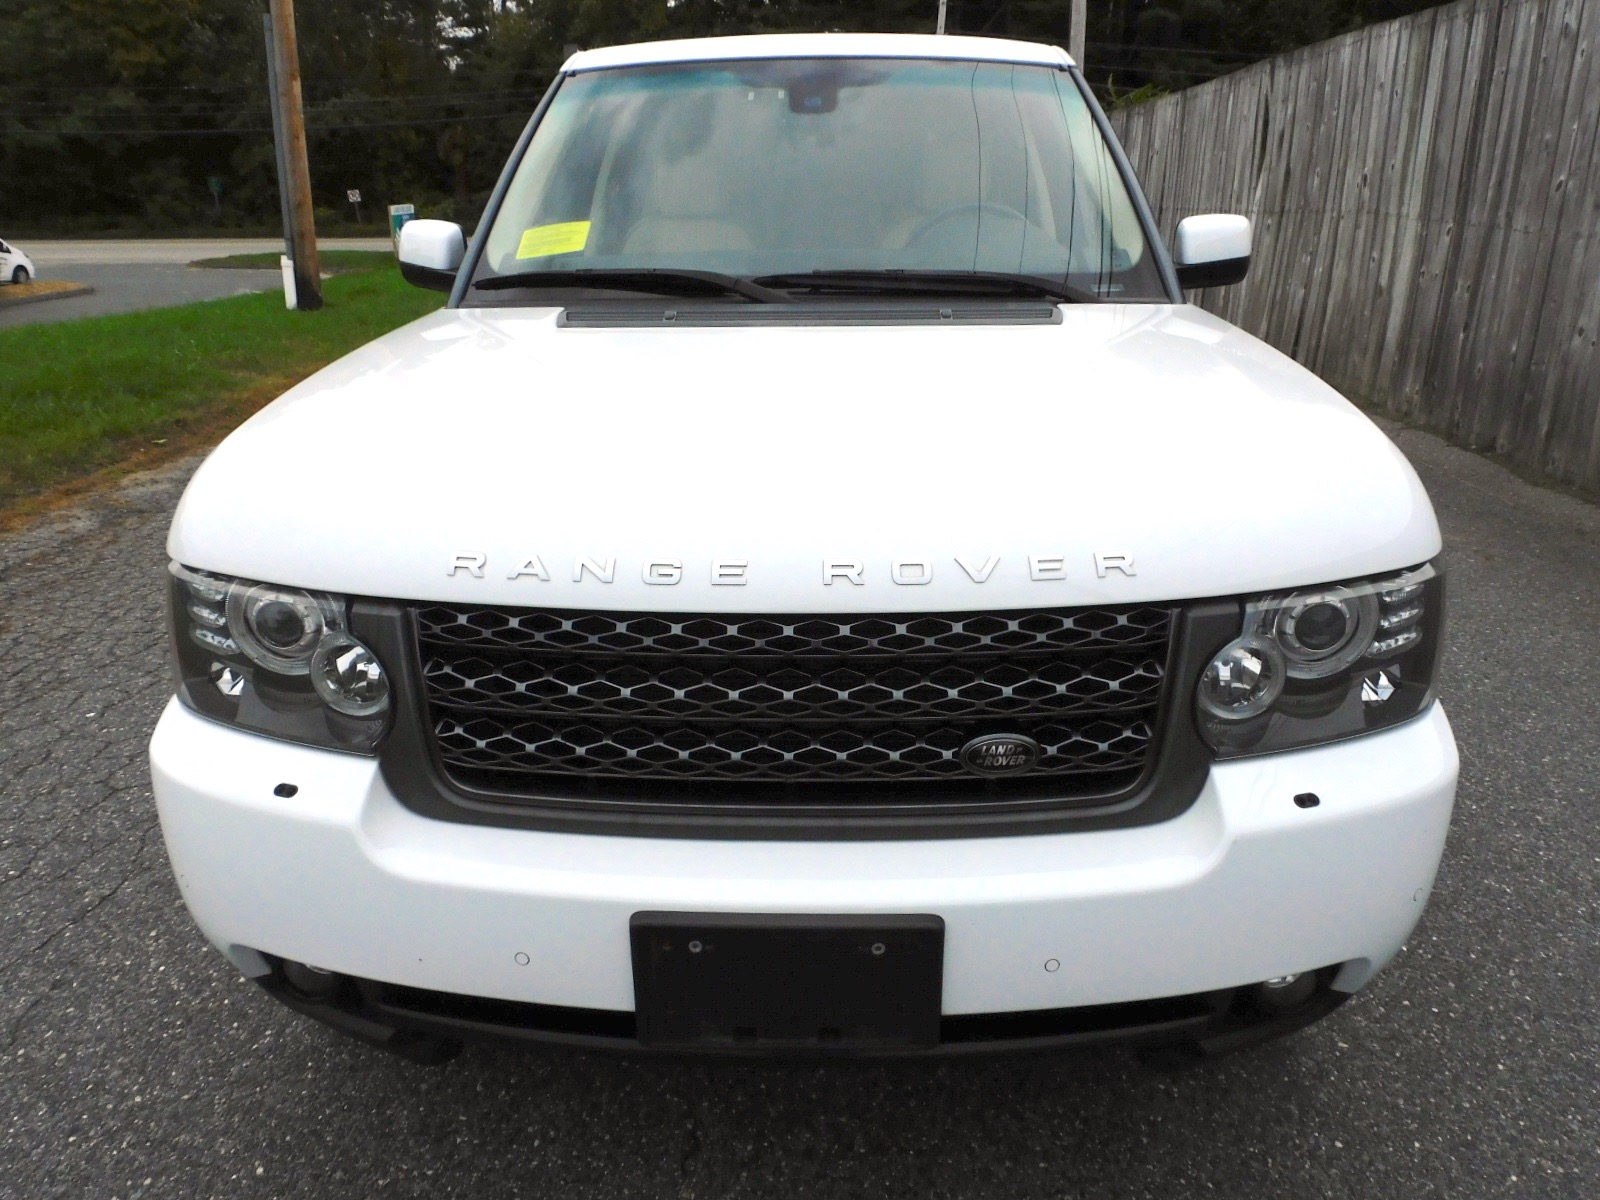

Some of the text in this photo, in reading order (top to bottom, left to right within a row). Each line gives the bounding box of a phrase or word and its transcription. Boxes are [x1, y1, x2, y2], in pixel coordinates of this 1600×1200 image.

[447, 551, 1137, 586] RANGE ROVER
[981, 745, 1015, 756] LAND
[984, 755, 1026, 767] ROVER
